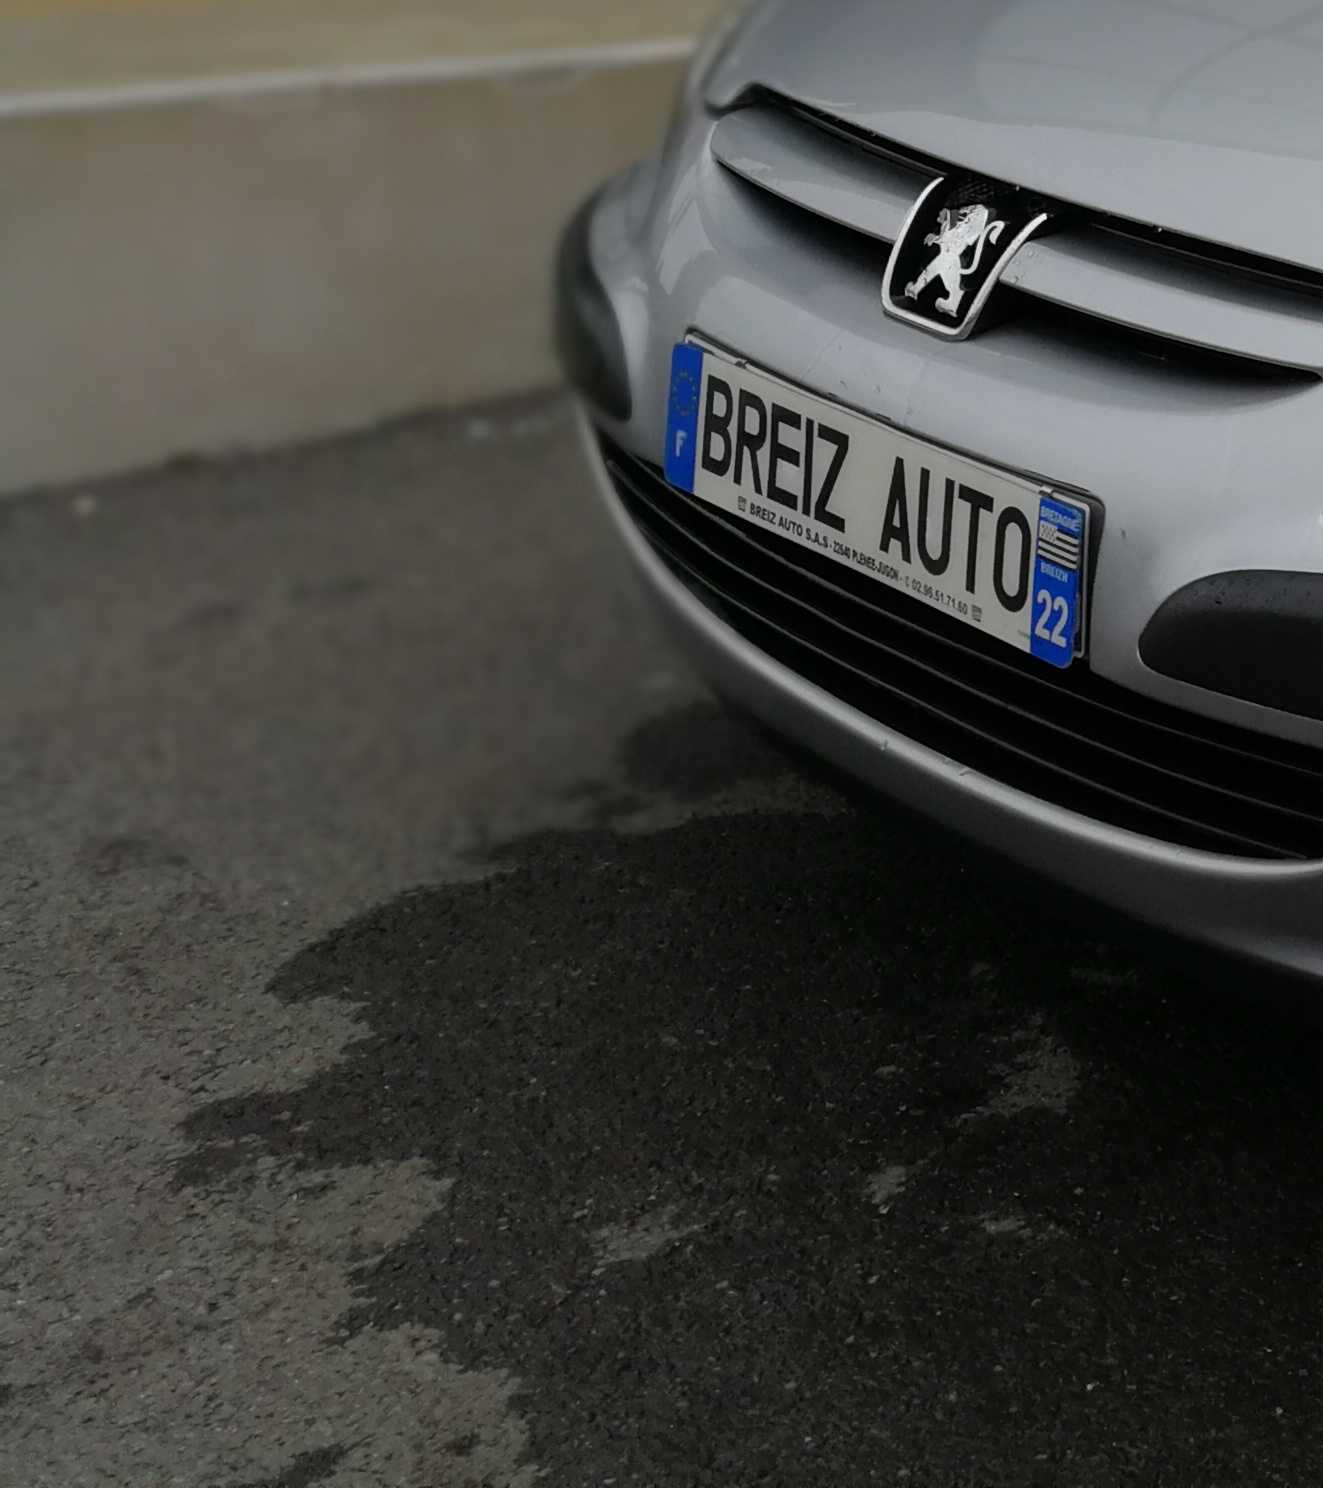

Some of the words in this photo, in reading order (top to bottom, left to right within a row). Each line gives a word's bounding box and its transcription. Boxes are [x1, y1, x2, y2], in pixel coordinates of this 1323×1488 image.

[674, 430, 688, 458] F
[701, 372, 850, 534] BREIZ
[878, 455, 1033, 614] AUTO
[750, 502, 776, 525] BREIZ
[778, 516, 803, 537] AUTO
[1034, 588, 1069, 649] 22
